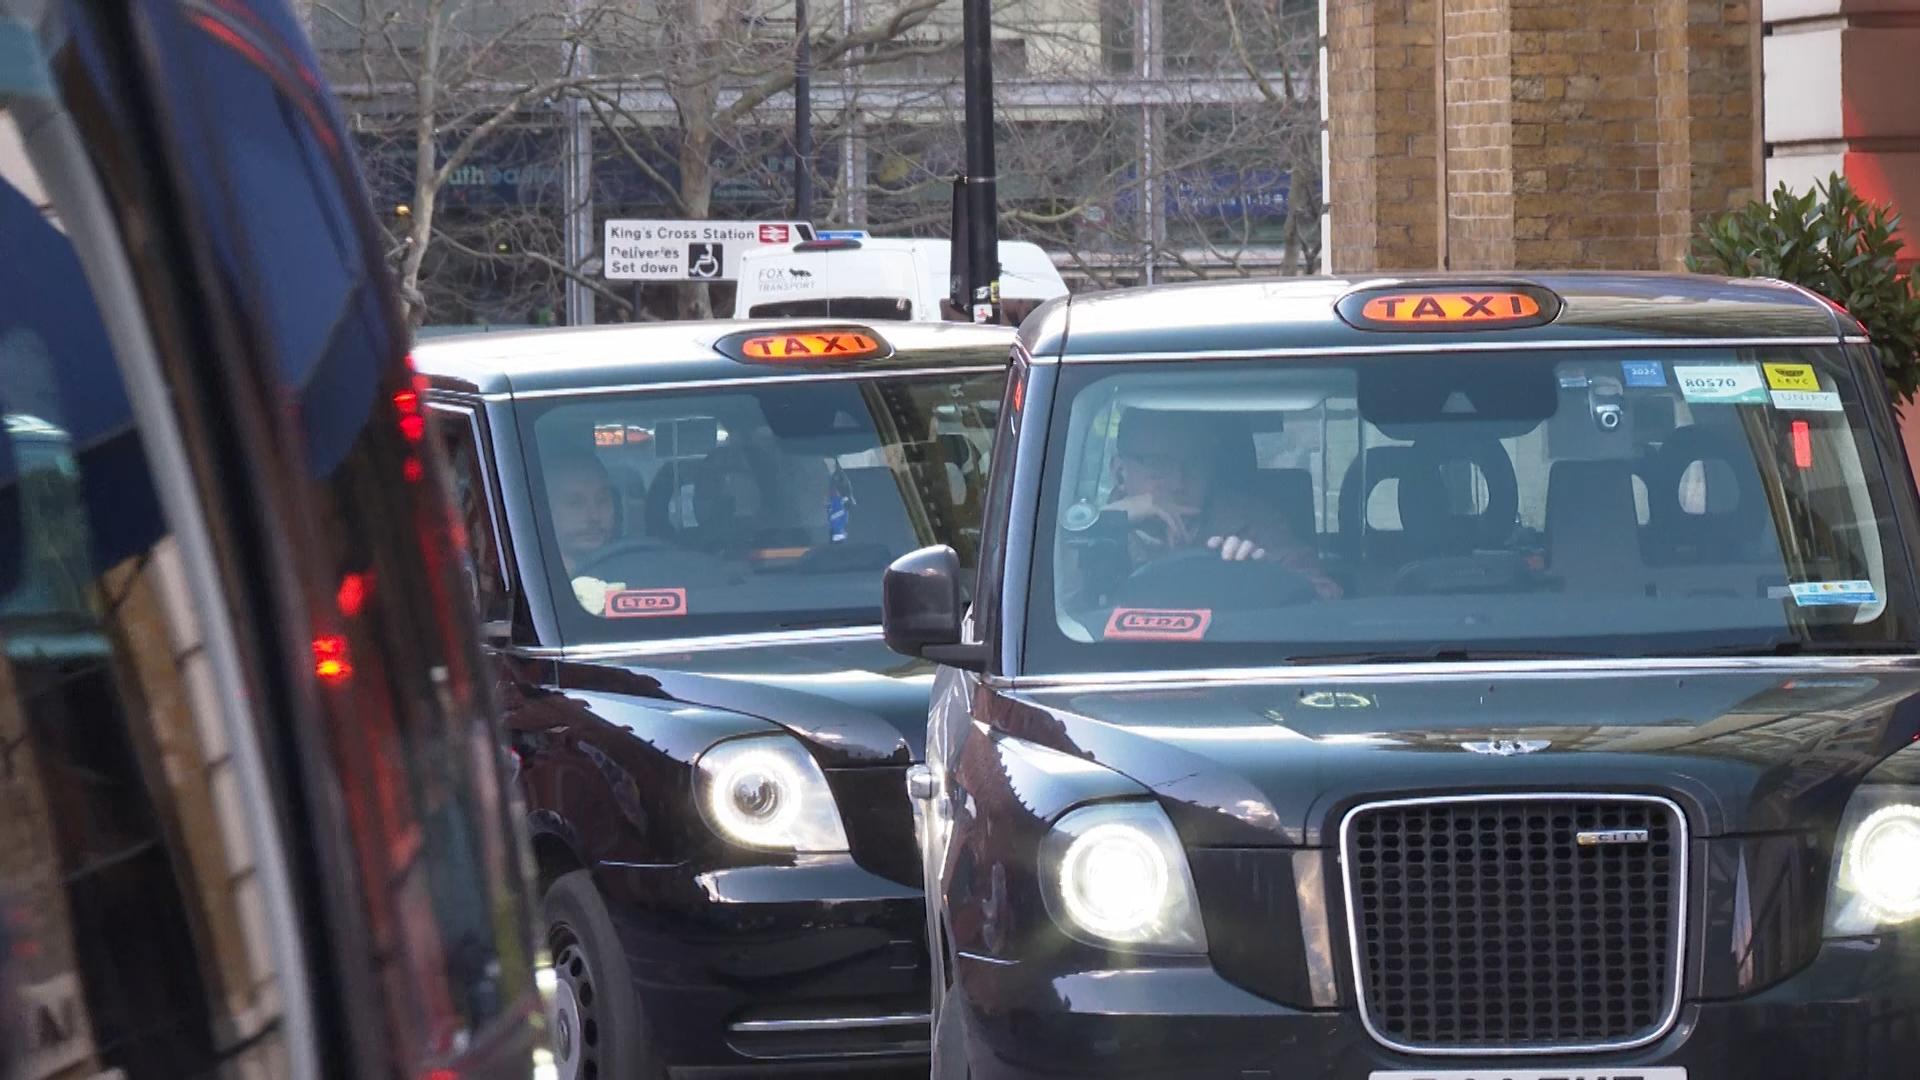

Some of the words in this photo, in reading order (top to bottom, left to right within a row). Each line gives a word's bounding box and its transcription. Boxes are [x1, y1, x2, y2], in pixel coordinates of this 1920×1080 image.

[610, 226, 653, 241] King's
[657, 226, 698, 240] Cross
[703, 227, 755, 240] Station
[611, 261, 636, 273] Set
[640, 262, 678, 273] down
[758, 267, 785, 280] FOX
[759, 281, 816, 292] TRANSPORT
[1377, 295, 1523, 319] TAXI
[752, 335, 867, 356] TAXI
[622, 597, 670, 607] LTDA
[1127, 615, 1187, 627] LTDA
